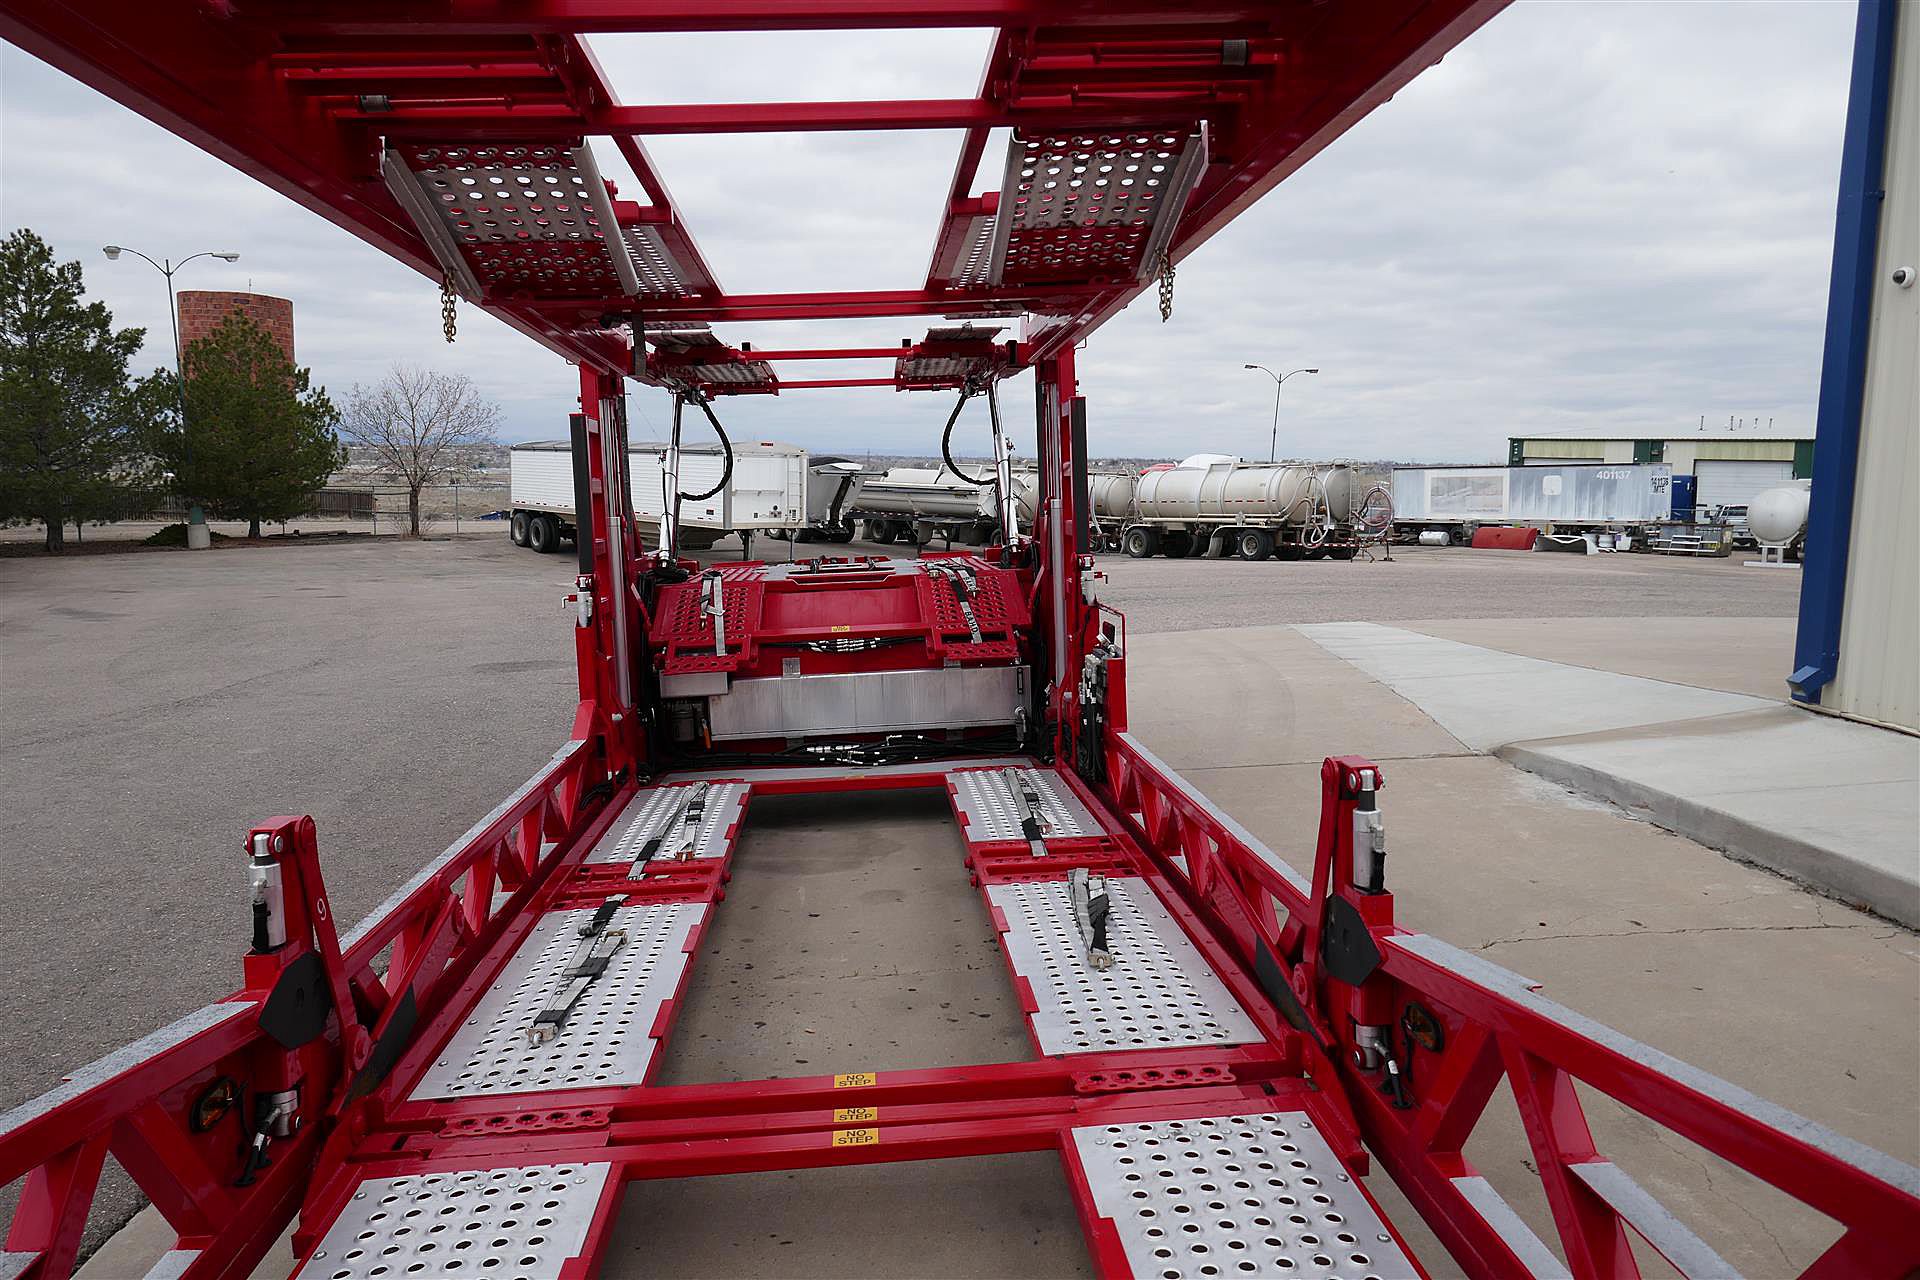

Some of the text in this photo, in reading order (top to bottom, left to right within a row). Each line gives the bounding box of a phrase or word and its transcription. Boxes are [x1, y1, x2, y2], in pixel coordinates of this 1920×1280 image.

[1596, 470, 1631, 480] 401137
[317, 898, 326, 921] 9
[838, 1135, 873, 1144] STEP
